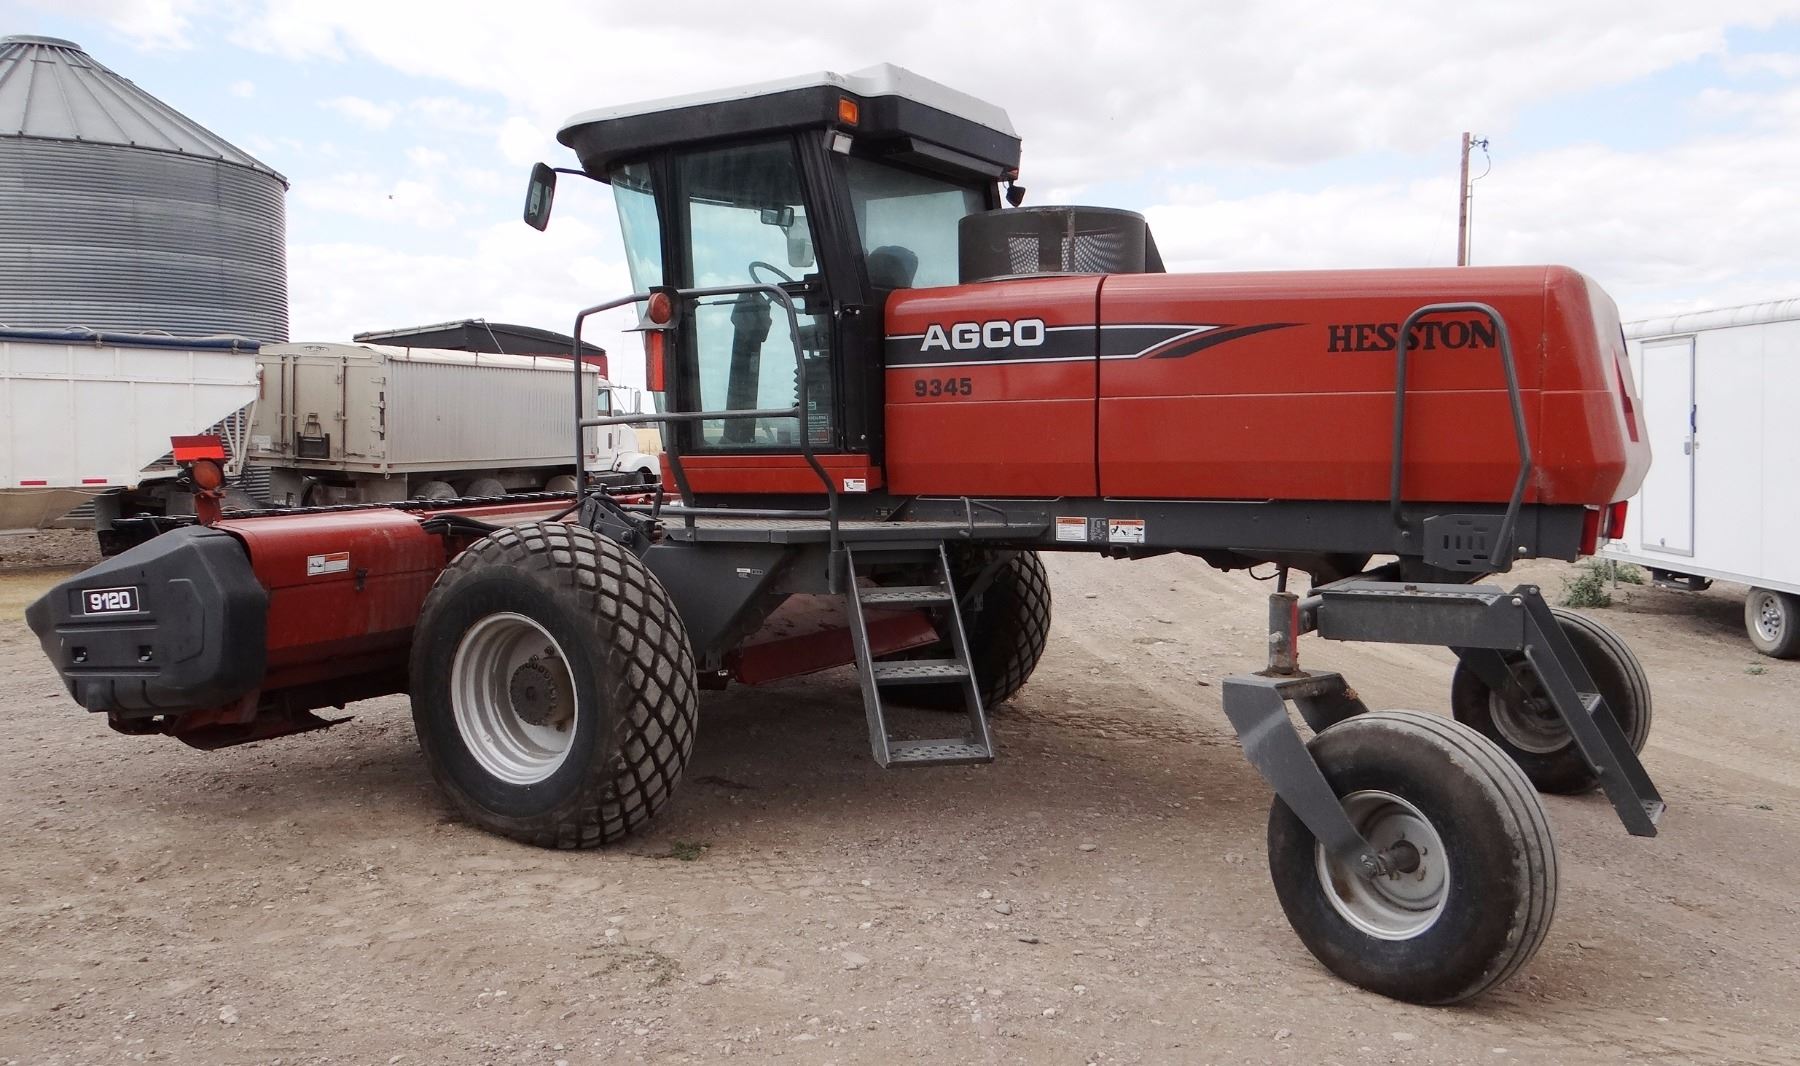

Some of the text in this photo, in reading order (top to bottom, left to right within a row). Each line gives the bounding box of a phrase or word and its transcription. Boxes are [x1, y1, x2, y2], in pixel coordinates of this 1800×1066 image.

[920, 318, 1045, 351] AGCO
[1327, 319, 1498, 352] HESSTON
[914, 377, 972, 397] 9345
[90, 591, 131, 610] 9120
